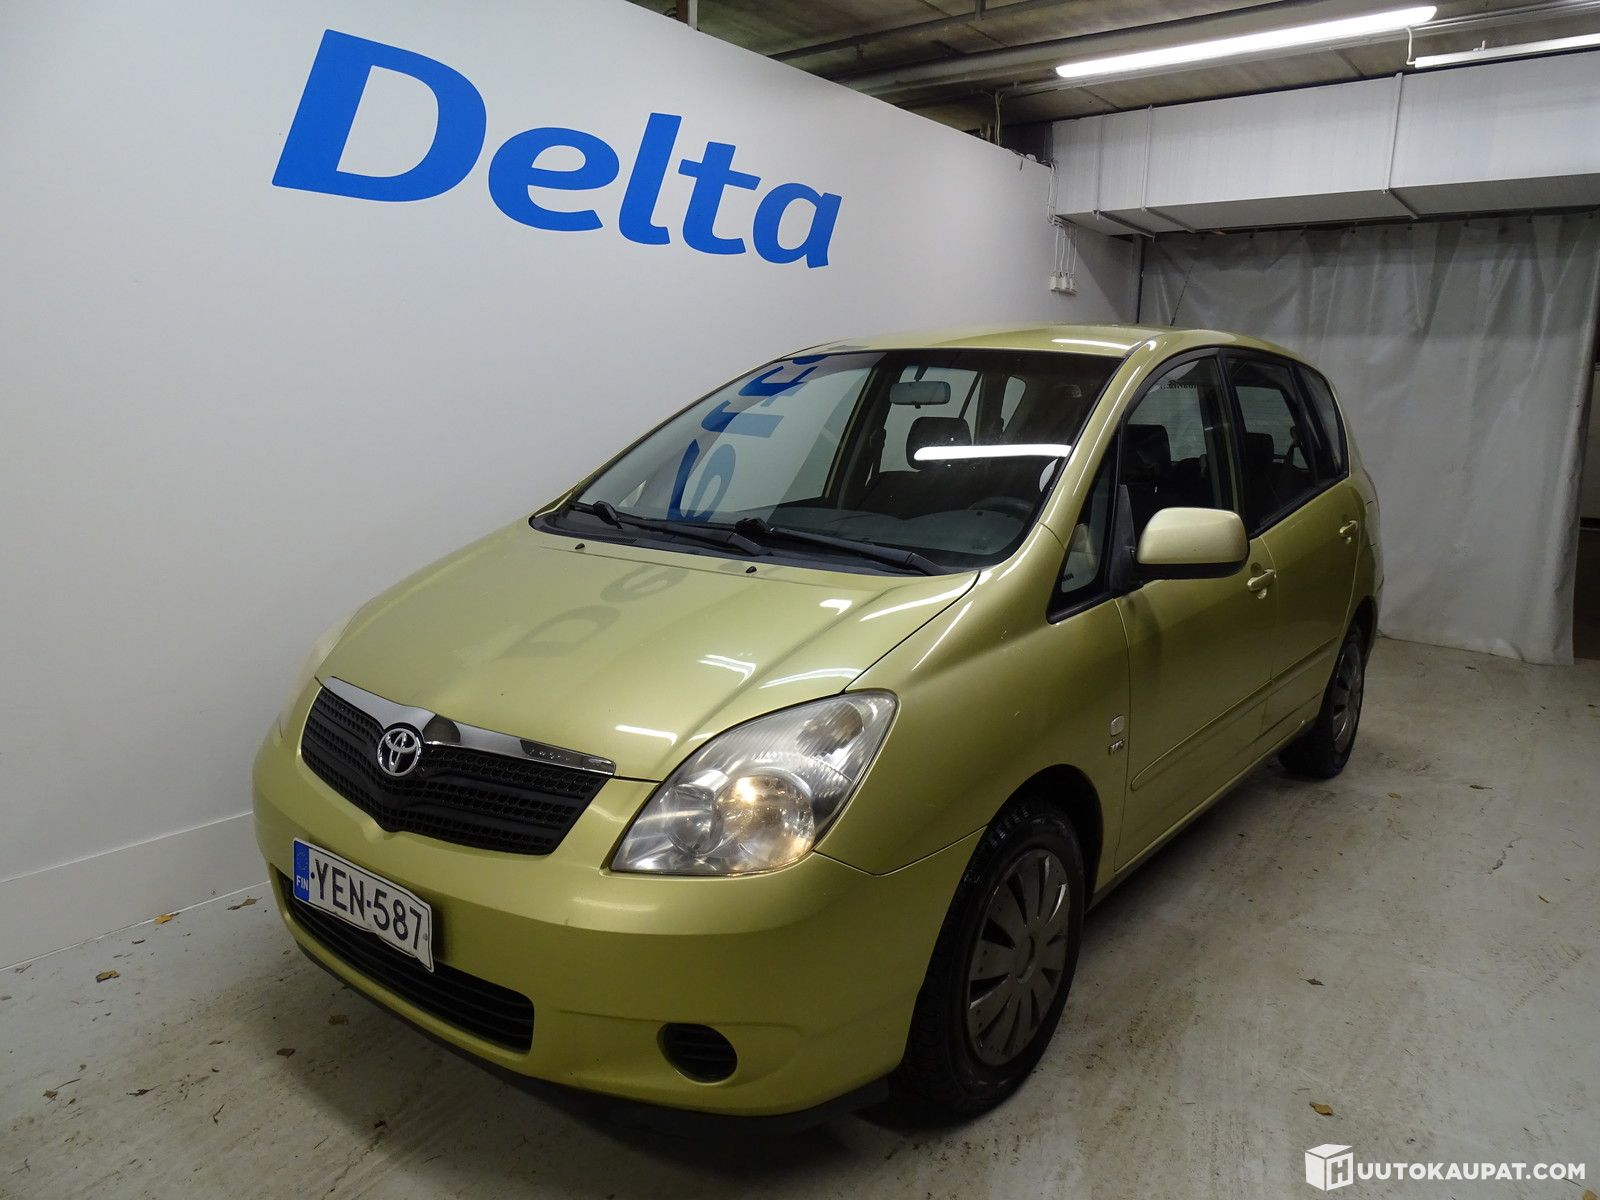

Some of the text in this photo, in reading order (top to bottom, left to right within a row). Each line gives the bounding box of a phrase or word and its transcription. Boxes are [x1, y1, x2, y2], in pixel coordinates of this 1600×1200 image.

[272, 29, 842, 268] Delta
[296, 875, 309, 891] FIN
[314, 859, 422, 950] YEN-587
